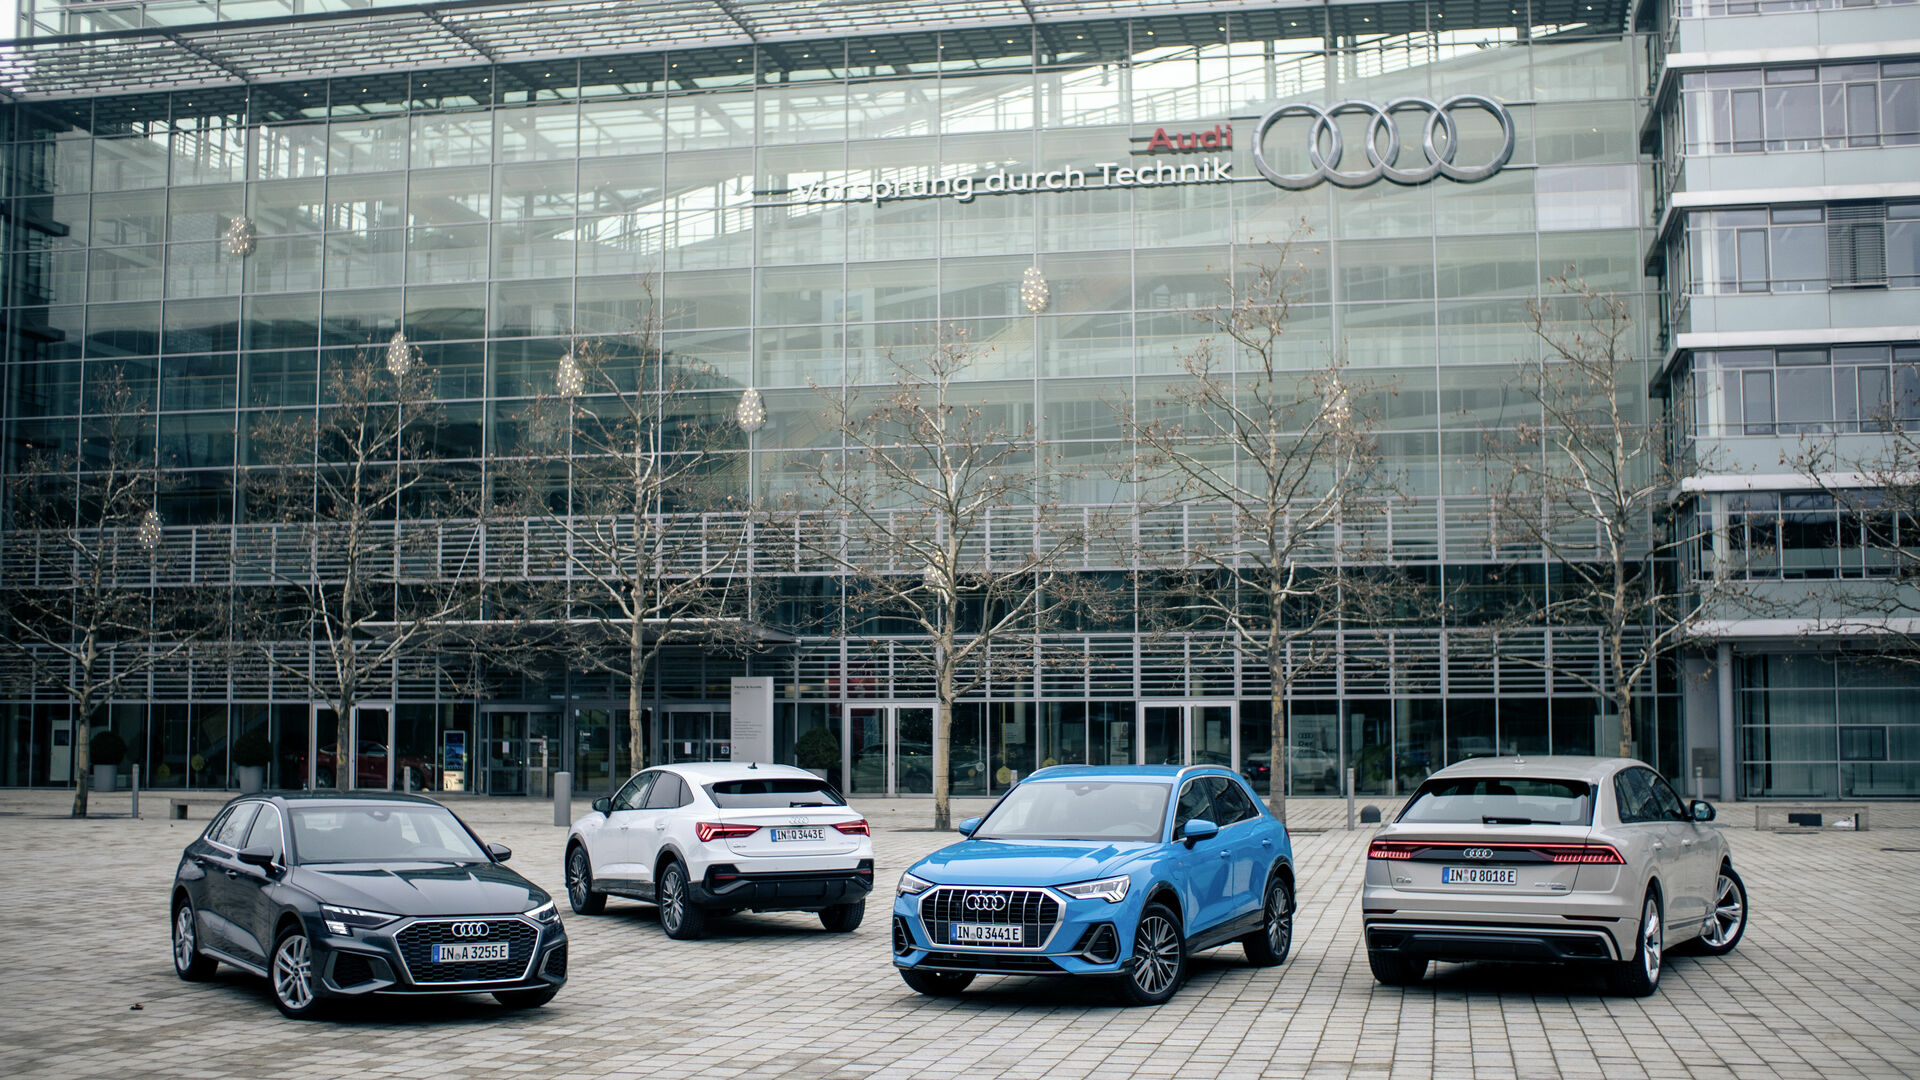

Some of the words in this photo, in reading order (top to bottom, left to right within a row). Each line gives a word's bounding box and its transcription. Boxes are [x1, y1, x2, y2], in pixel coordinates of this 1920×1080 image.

[1147, 124, 1232, 150] Audi
[797, 174, 973, 204] Vorsprung
[985, 164, 1085, 192] durch
[1095, 157, 1232, 186] Technik
[1450, 869, 1463, 881] IN
[957, 926, 970, 939] IN
[440, 946, 455, 960] IN
